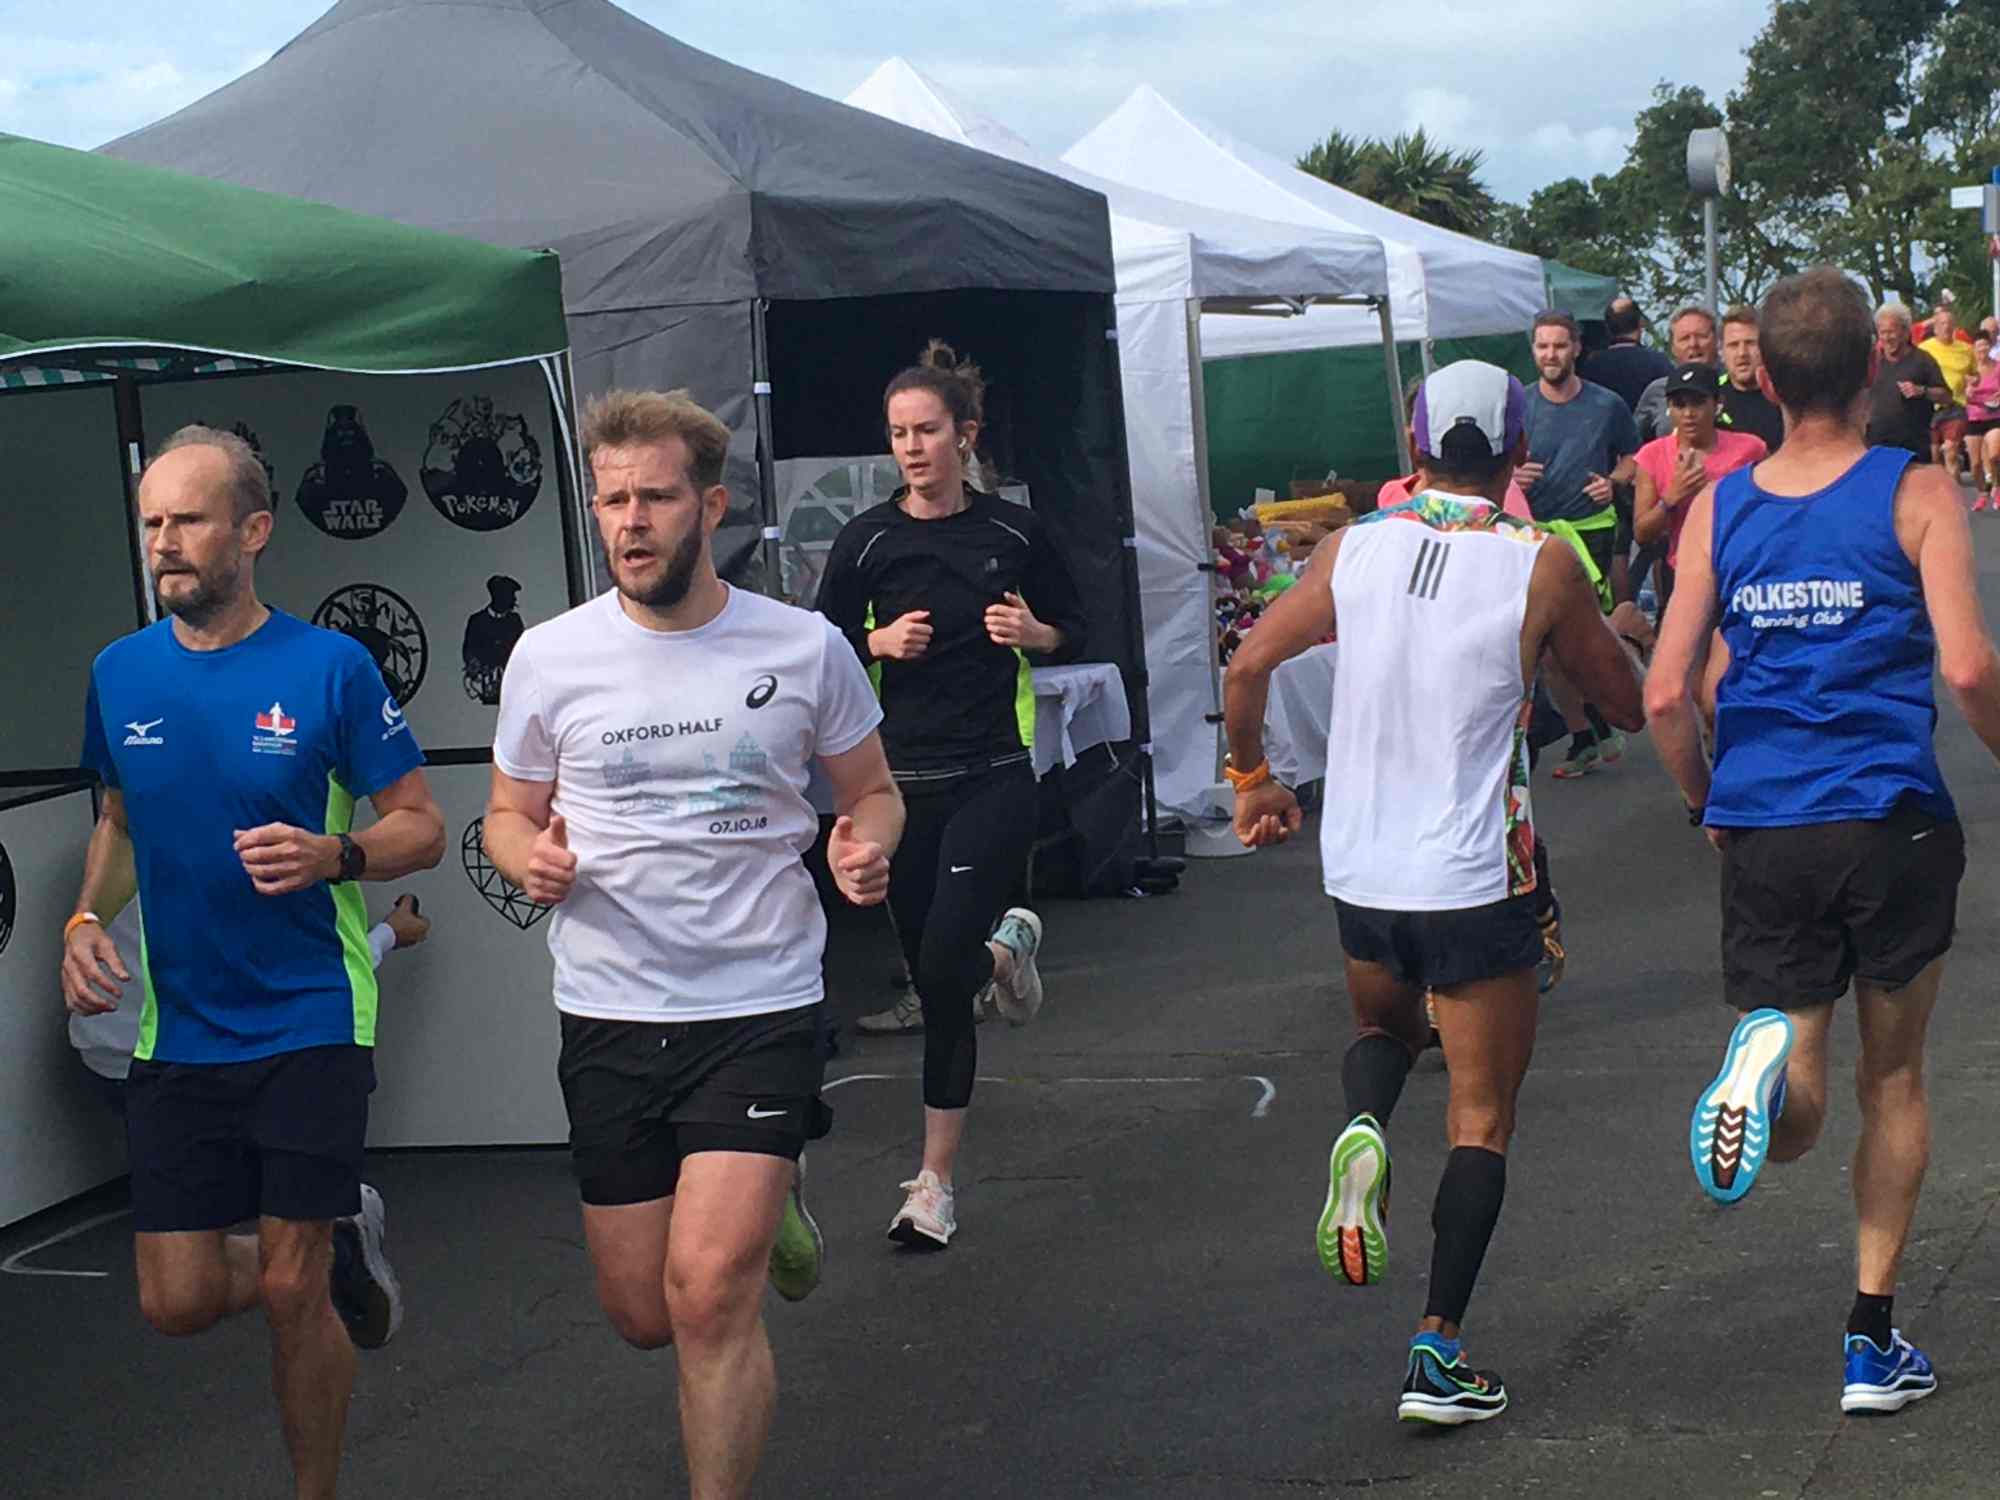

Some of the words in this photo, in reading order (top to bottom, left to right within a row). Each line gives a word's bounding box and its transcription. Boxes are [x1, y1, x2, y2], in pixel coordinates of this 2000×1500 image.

[321, 499, 384, 515] STAR
[322, 513, 384, 531] WARS
[1732, 580, 1864, 613] FOLKESTONE
[1751, 614, 1809, 629] Running
[1812, 611, 1845, 625] Club
[601, 723, 675, 746] OXFORD
[678, 717, 724, 736] HALF
[708, 816, 768, 834] 07.10.18
